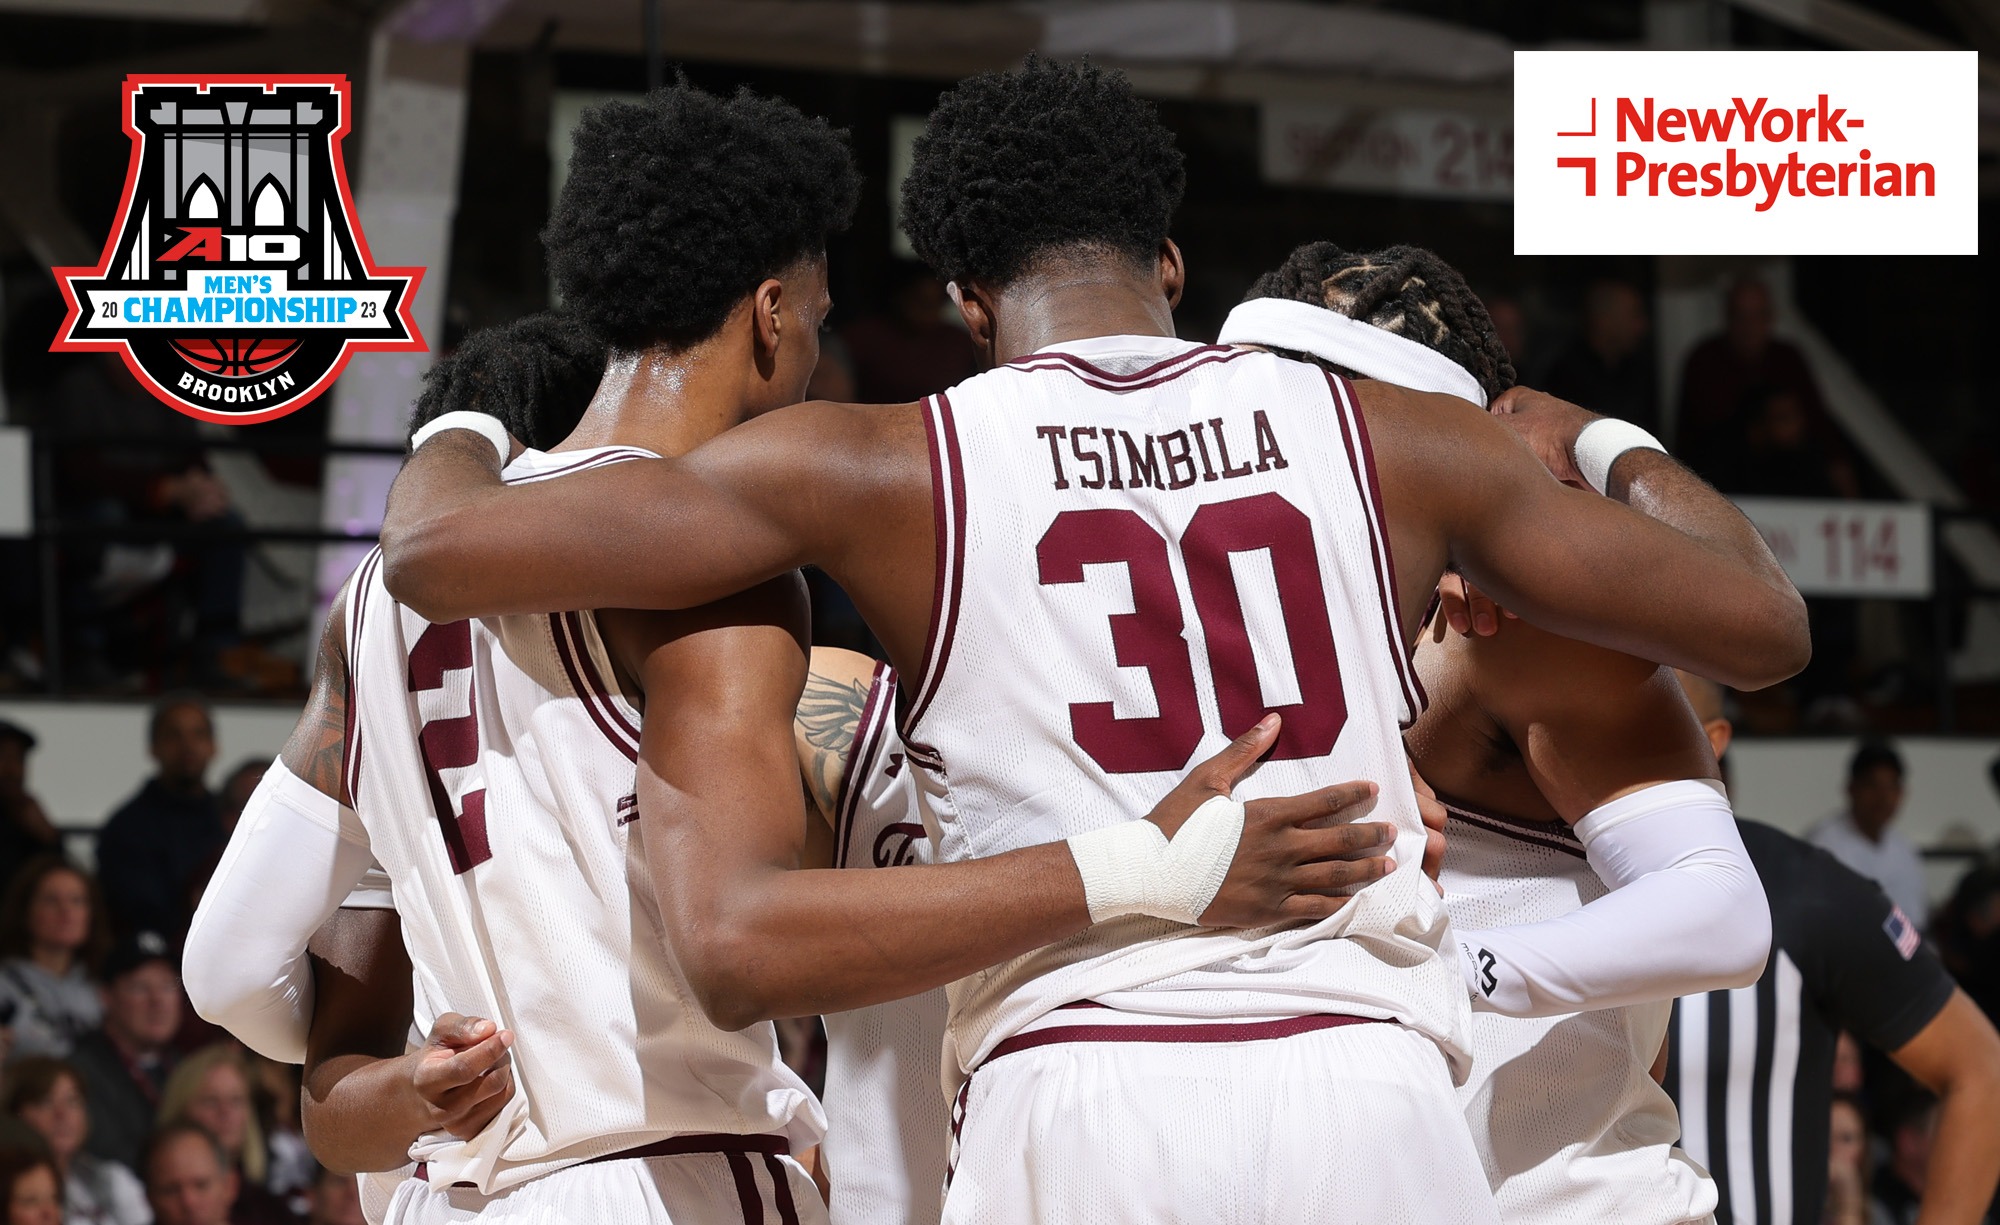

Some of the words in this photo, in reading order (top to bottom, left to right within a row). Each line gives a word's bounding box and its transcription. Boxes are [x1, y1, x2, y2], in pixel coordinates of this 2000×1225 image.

[1036, 410, 1289, 491] TSIMBILA
[1036, 491, 1348, 773] 30
[1820, 513, 1901, 582] 114
[408, 618, 493, 875] 2
